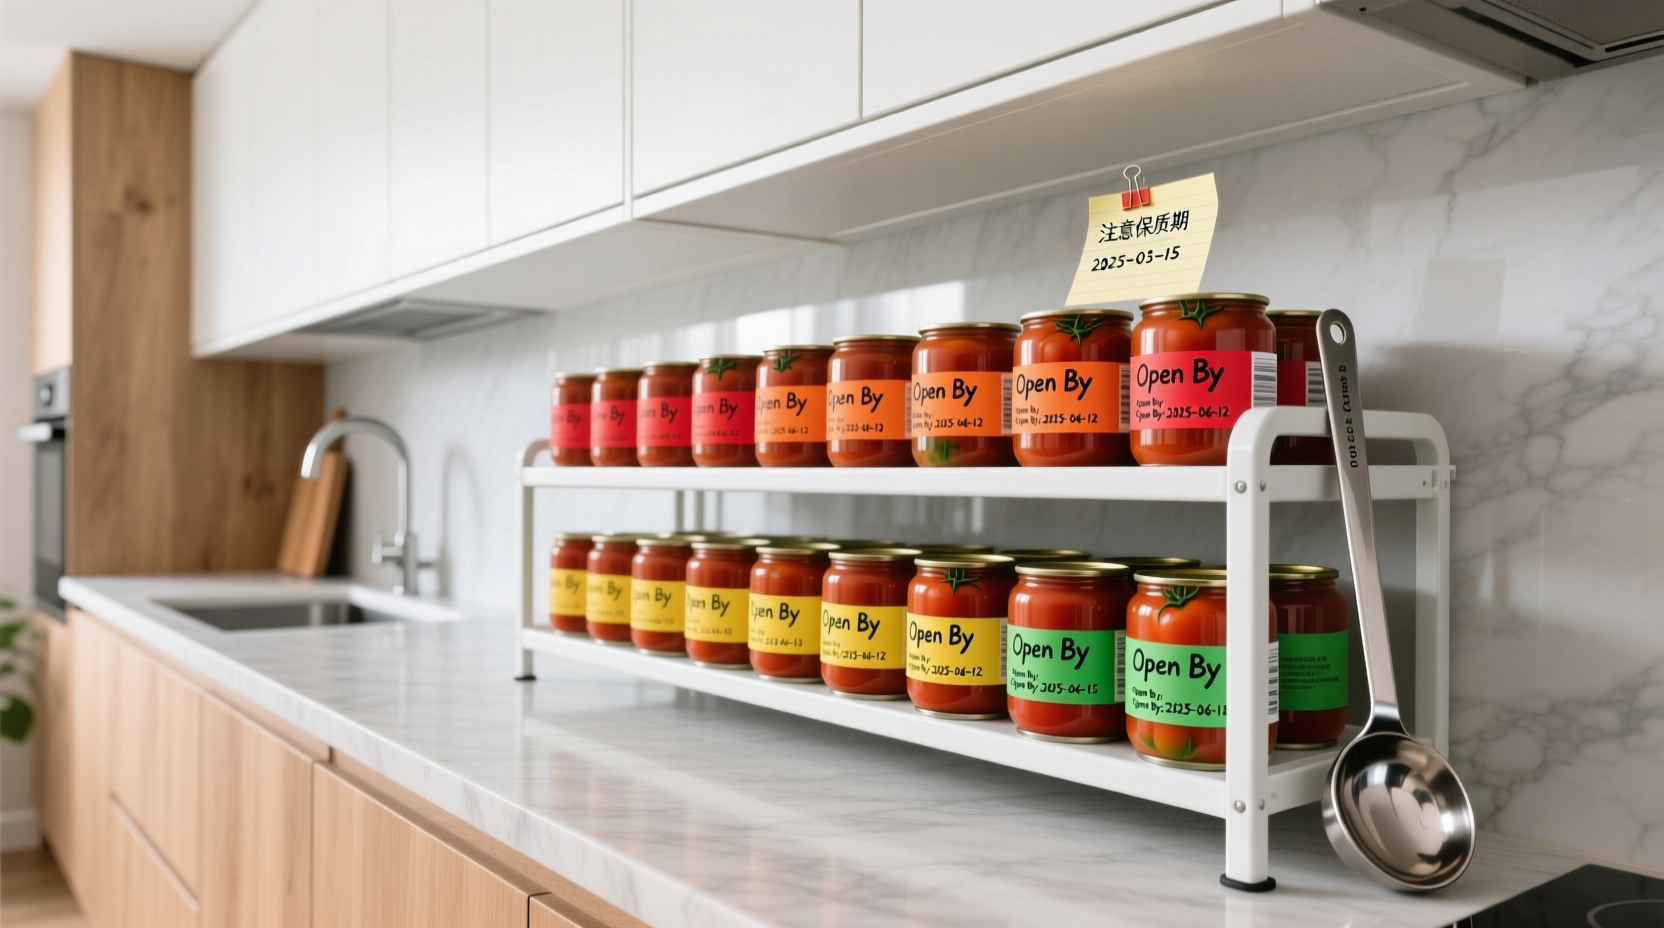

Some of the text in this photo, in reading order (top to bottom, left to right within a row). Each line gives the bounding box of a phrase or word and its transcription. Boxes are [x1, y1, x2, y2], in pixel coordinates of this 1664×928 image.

[1099, 210, 1189, 243] 注意保质期
[1017, 369, 1092, 401] Open By
[1137, 358, 1224, 393] Open By
[786, 392, 807, 416] By
[828, 386, 883, 413] Open By
[914, 378, 977, 407] Open By
[661, 402, 678, 424] By
[719, 398, 738, 420] By
[607, 581, 623, 601] By
[655, 587, 671, 608] By
[712, 594, 730, 617] By
[779, 603, 800, 627] By
[823, 609, 880, 640] Open By
[910, 621, 974, 655] Open By
[1013, 633, 1090, 670] Open By
[1133, 648, 1221, 689] Open By
